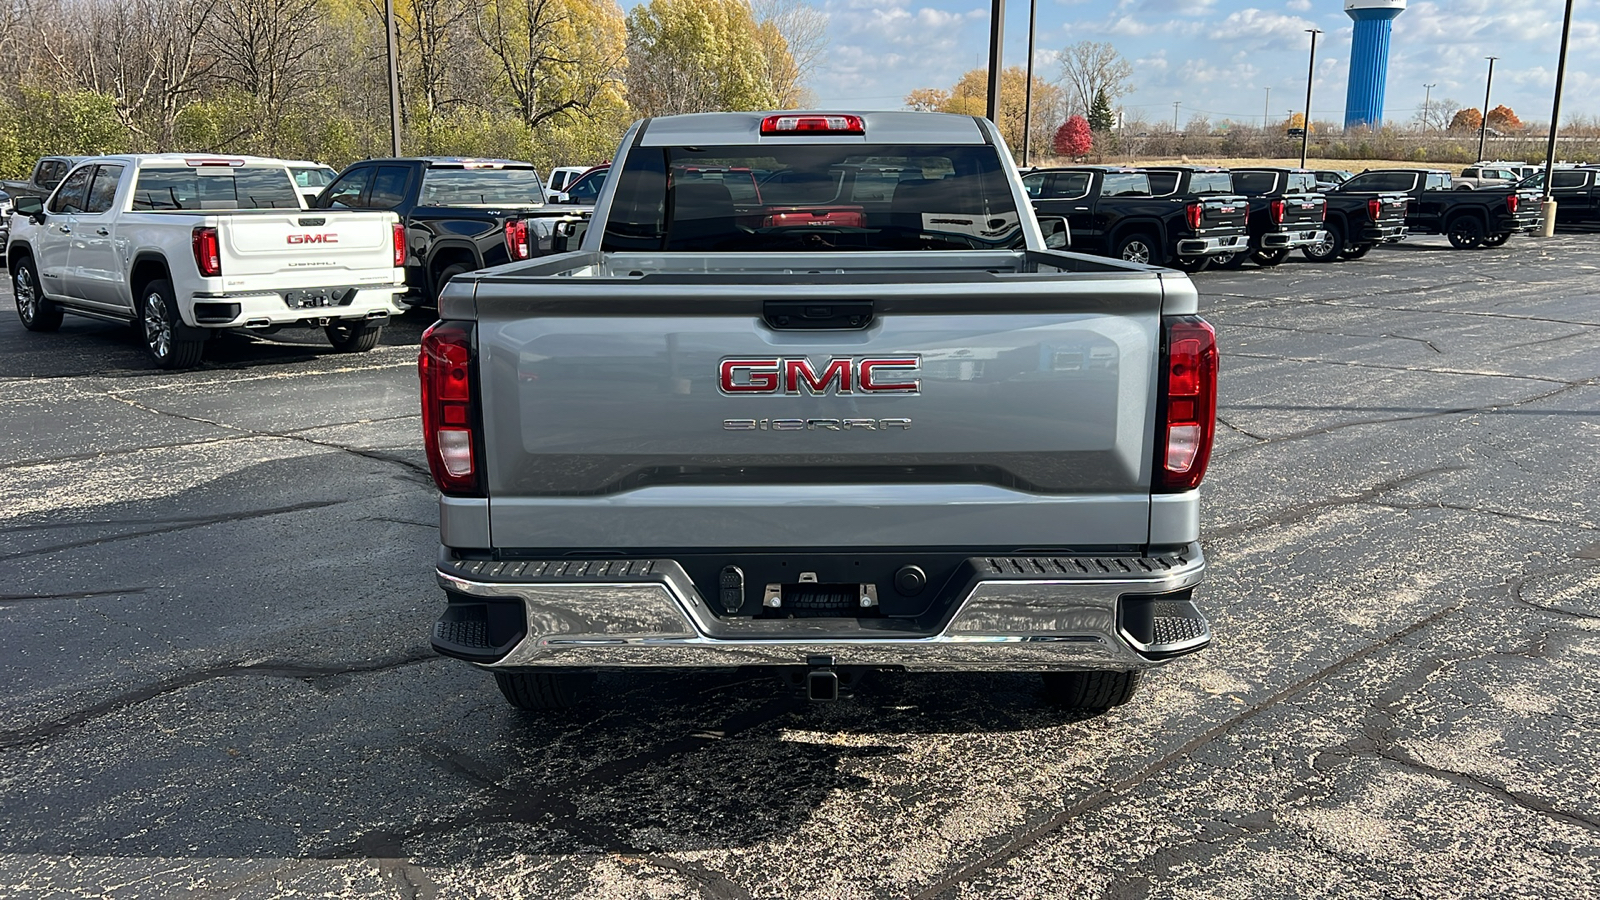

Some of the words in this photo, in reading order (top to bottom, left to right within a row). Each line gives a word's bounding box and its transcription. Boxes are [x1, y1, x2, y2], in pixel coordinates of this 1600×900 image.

[287, 233, 339, 244] GMC
[717, 355, 923, 397] GMC
[722, 418, 912, 431] SIERRA
